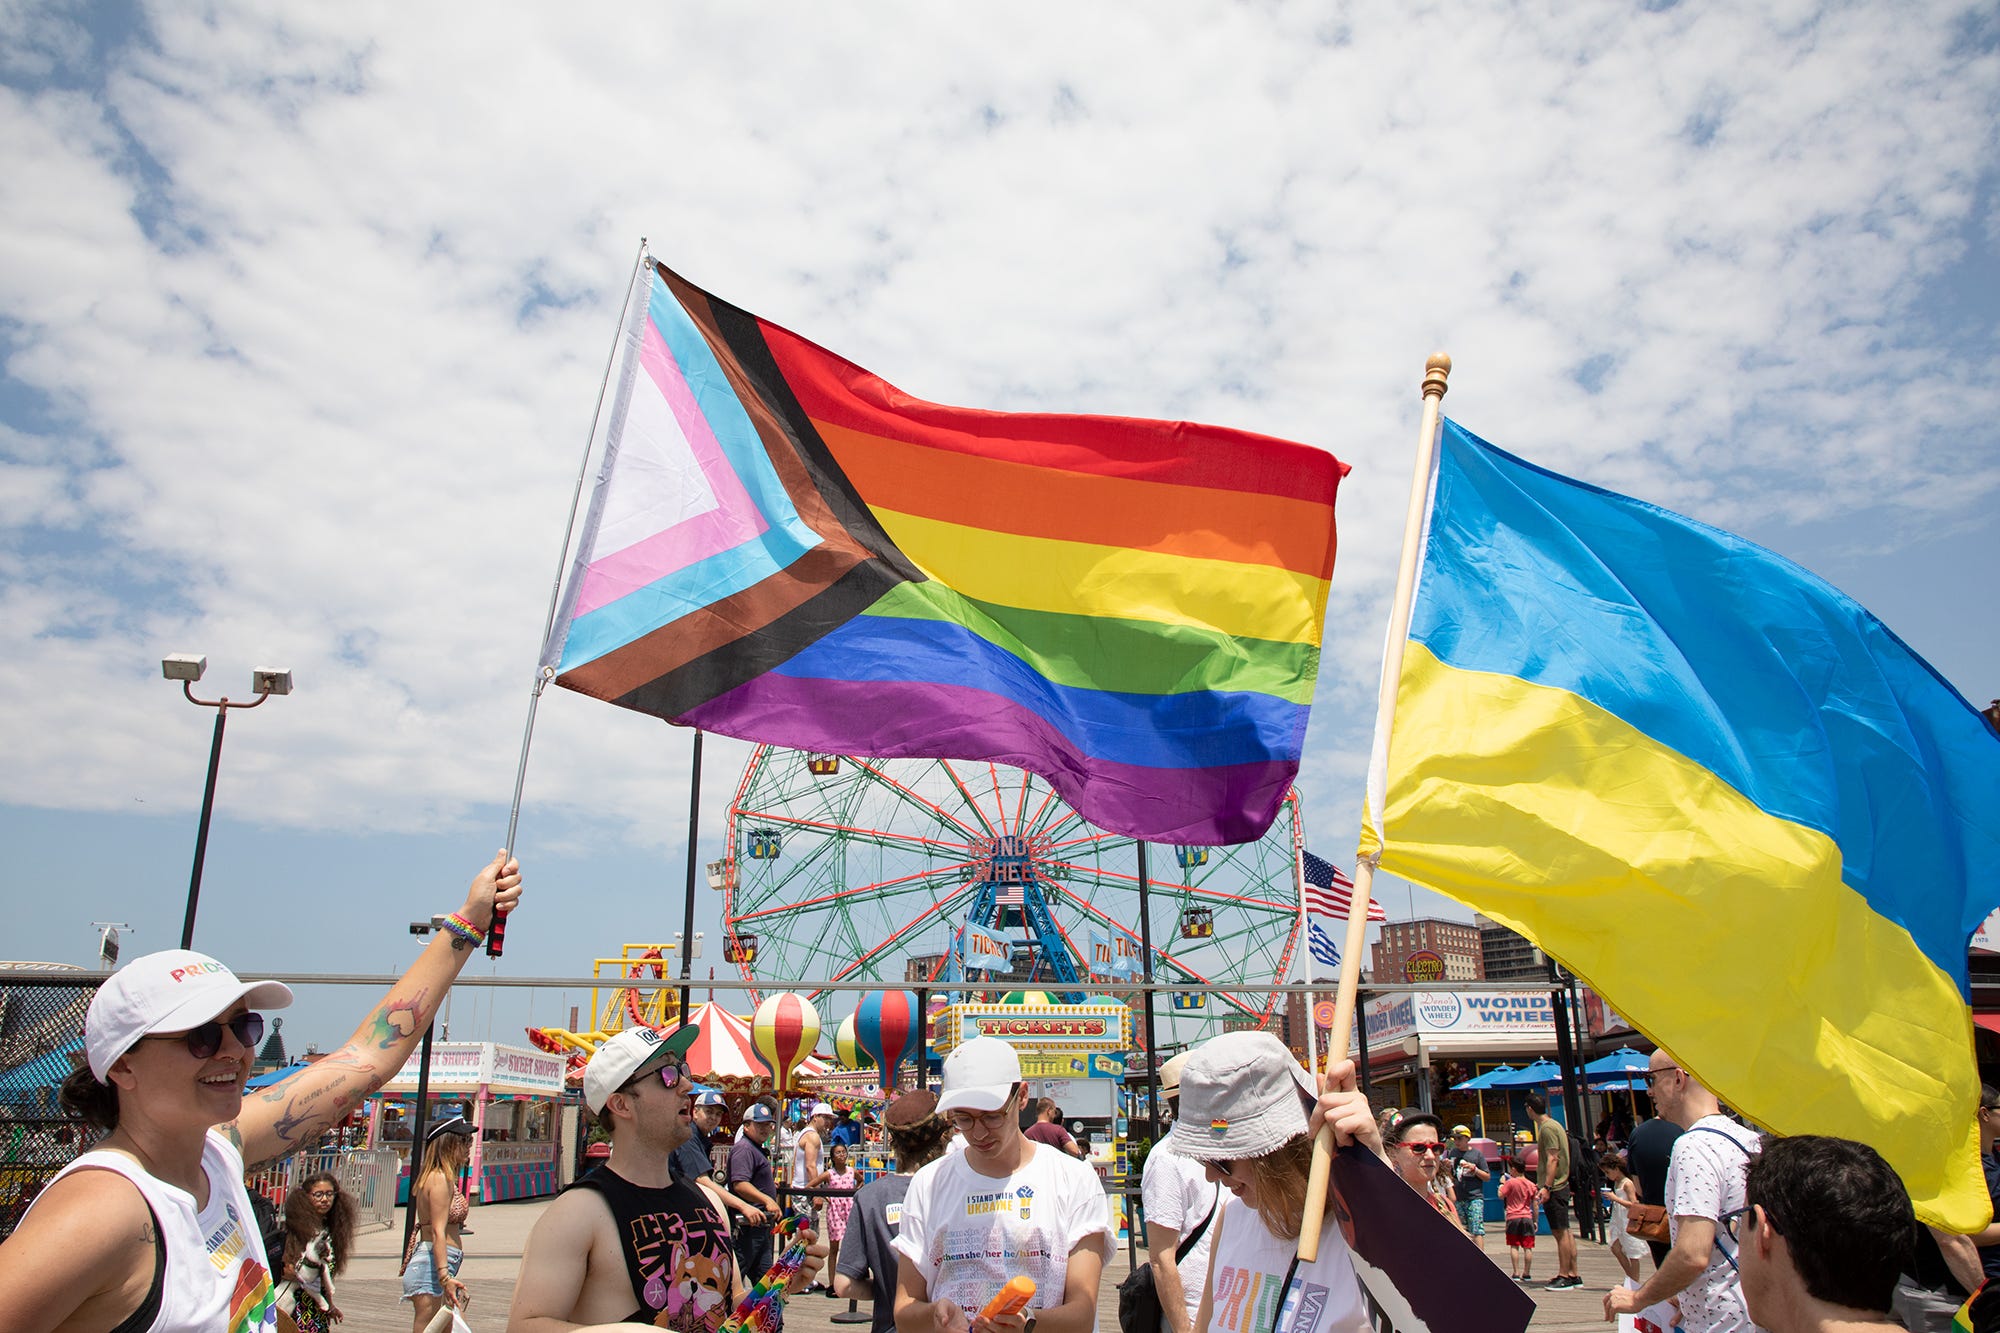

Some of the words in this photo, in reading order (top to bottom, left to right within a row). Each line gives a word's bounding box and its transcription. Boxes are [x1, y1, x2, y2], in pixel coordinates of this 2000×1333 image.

[967, 836, 1052, 857] WONDER
[975, 861, 1046, 882] WHEEL
[1406, 960, 1443, 973] ELECTRO
[1466, 997, 1582, 1009] WONDR
[1366, 1012, 1388, 1036] ONDER
[1388, 997, 1416, 1028] WHEEL
[1479, 1011, 1571, 1022] WHEE
[978, 1018, 1106, 1036] TICKETS
[407, 1051, 441, 1067] SWET
[442, 1051, 480, 1066] SHOPPE
[508, 1054, 534, 1074] SWEET
[534, 1059, 560, 1078] SHOPPE
[972, 1194, 994, 1203] STAND
[994, 1192, 1014, 1200] WITH
[967, 1200, 1013, 1215] UKRAINE
[965, 1249, 1002, 1260] she/her
[1003, 1249, 1040, 1260] he/him
[649, 1283, 663, 1302] 犬
